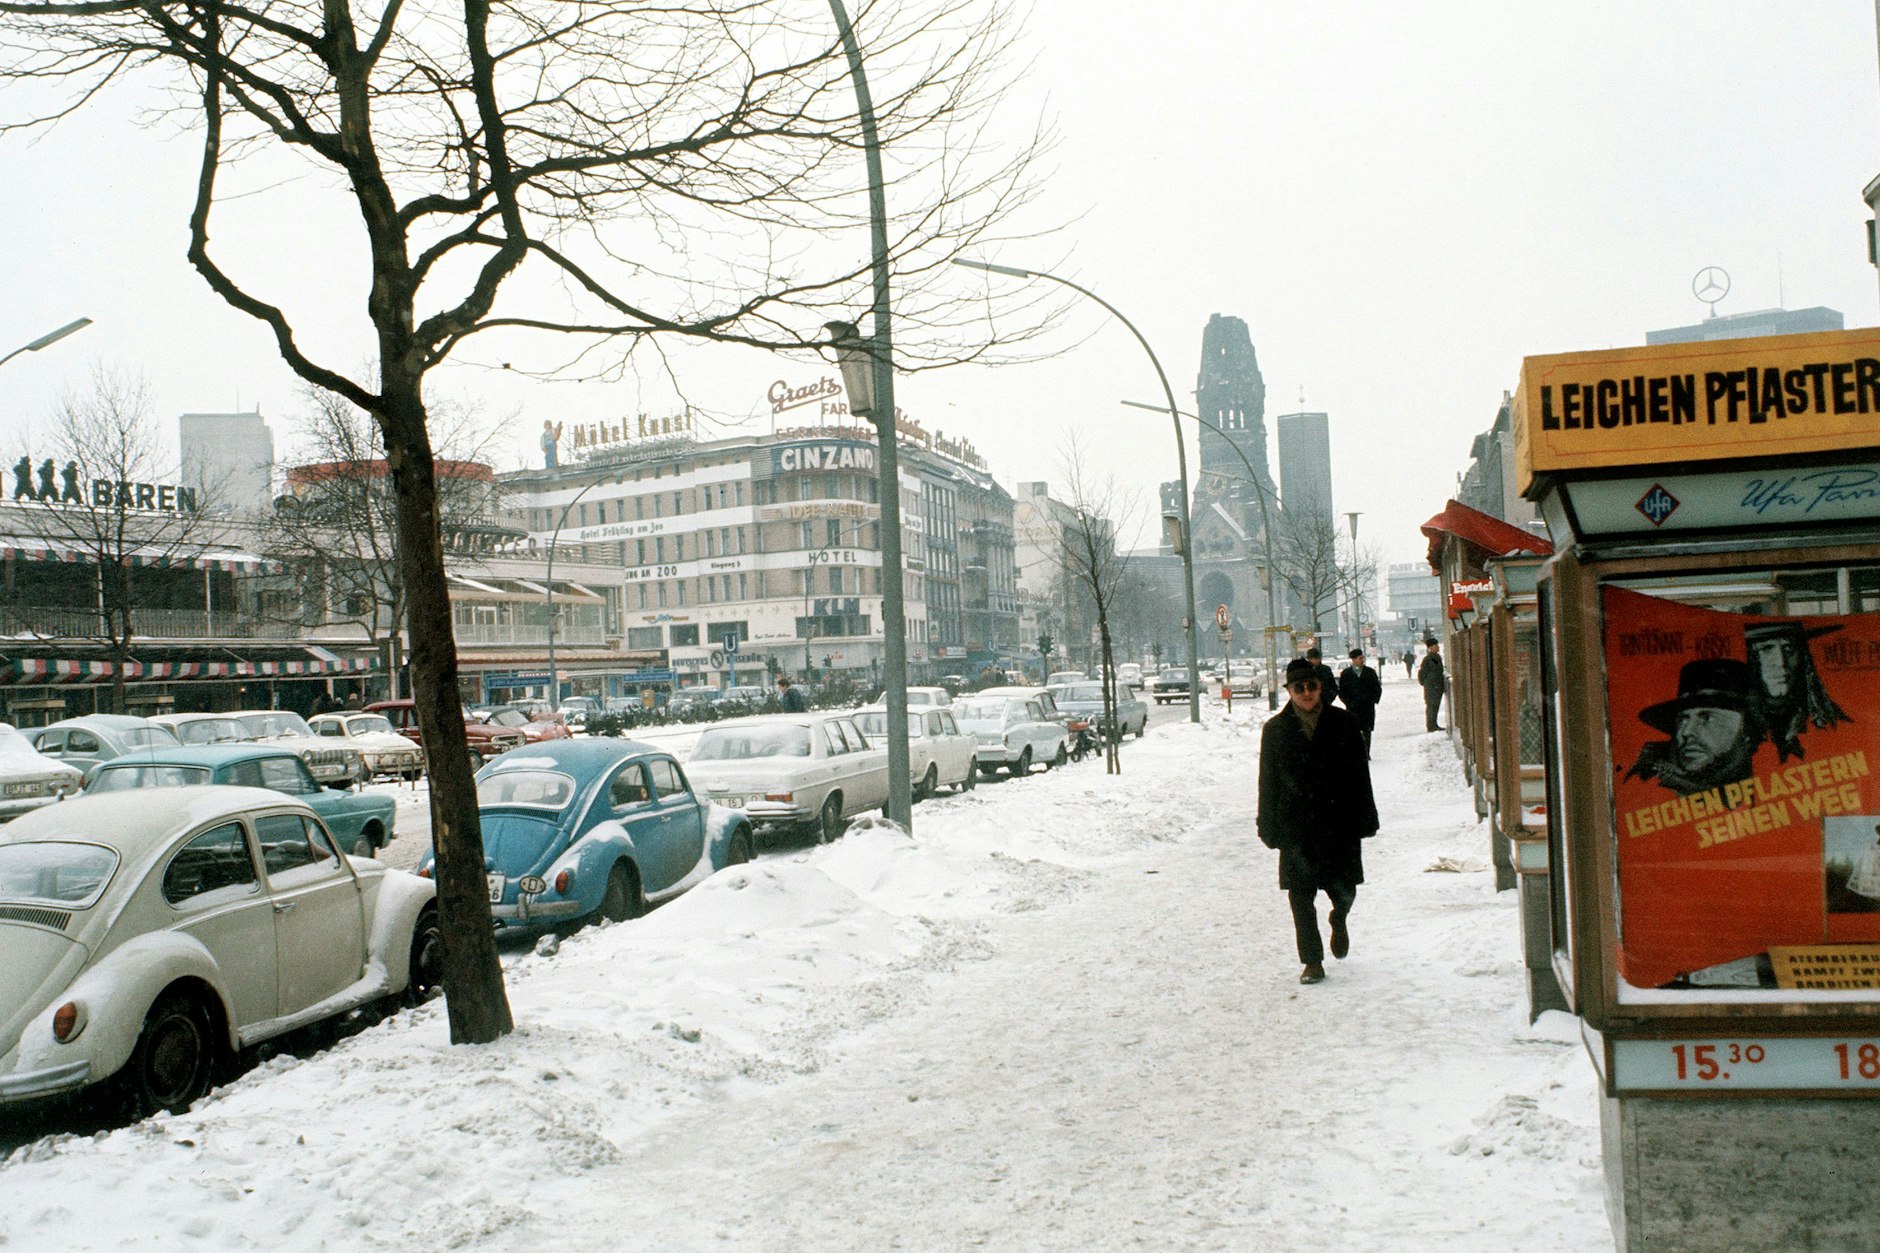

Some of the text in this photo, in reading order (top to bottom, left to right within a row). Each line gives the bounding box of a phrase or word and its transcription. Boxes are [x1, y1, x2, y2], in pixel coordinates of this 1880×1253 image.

[767, 376, 843, 414] Graetz
[1541, 357, 1880, 431] LEICHEN PFLASTER
[822, 403, 848, 415] FAR
[574, 405, 692, 448] Möbel Kunst
[780, 446, 874, 471] CINZANO
[808, 551, 857, 563] HOTEL
[657, 566, 678, 577] ZOO
[813, 598, 860, 615] KLM
[725, 635, 736, 652] U
[1624, 751, 1869, 838] LEICHEN PFLASTERN
[1695, 784, 1861, 849] SEINEN WEG
[528, 879, 537, 890] D
[1834, 1042, 1880, 1081] 18
